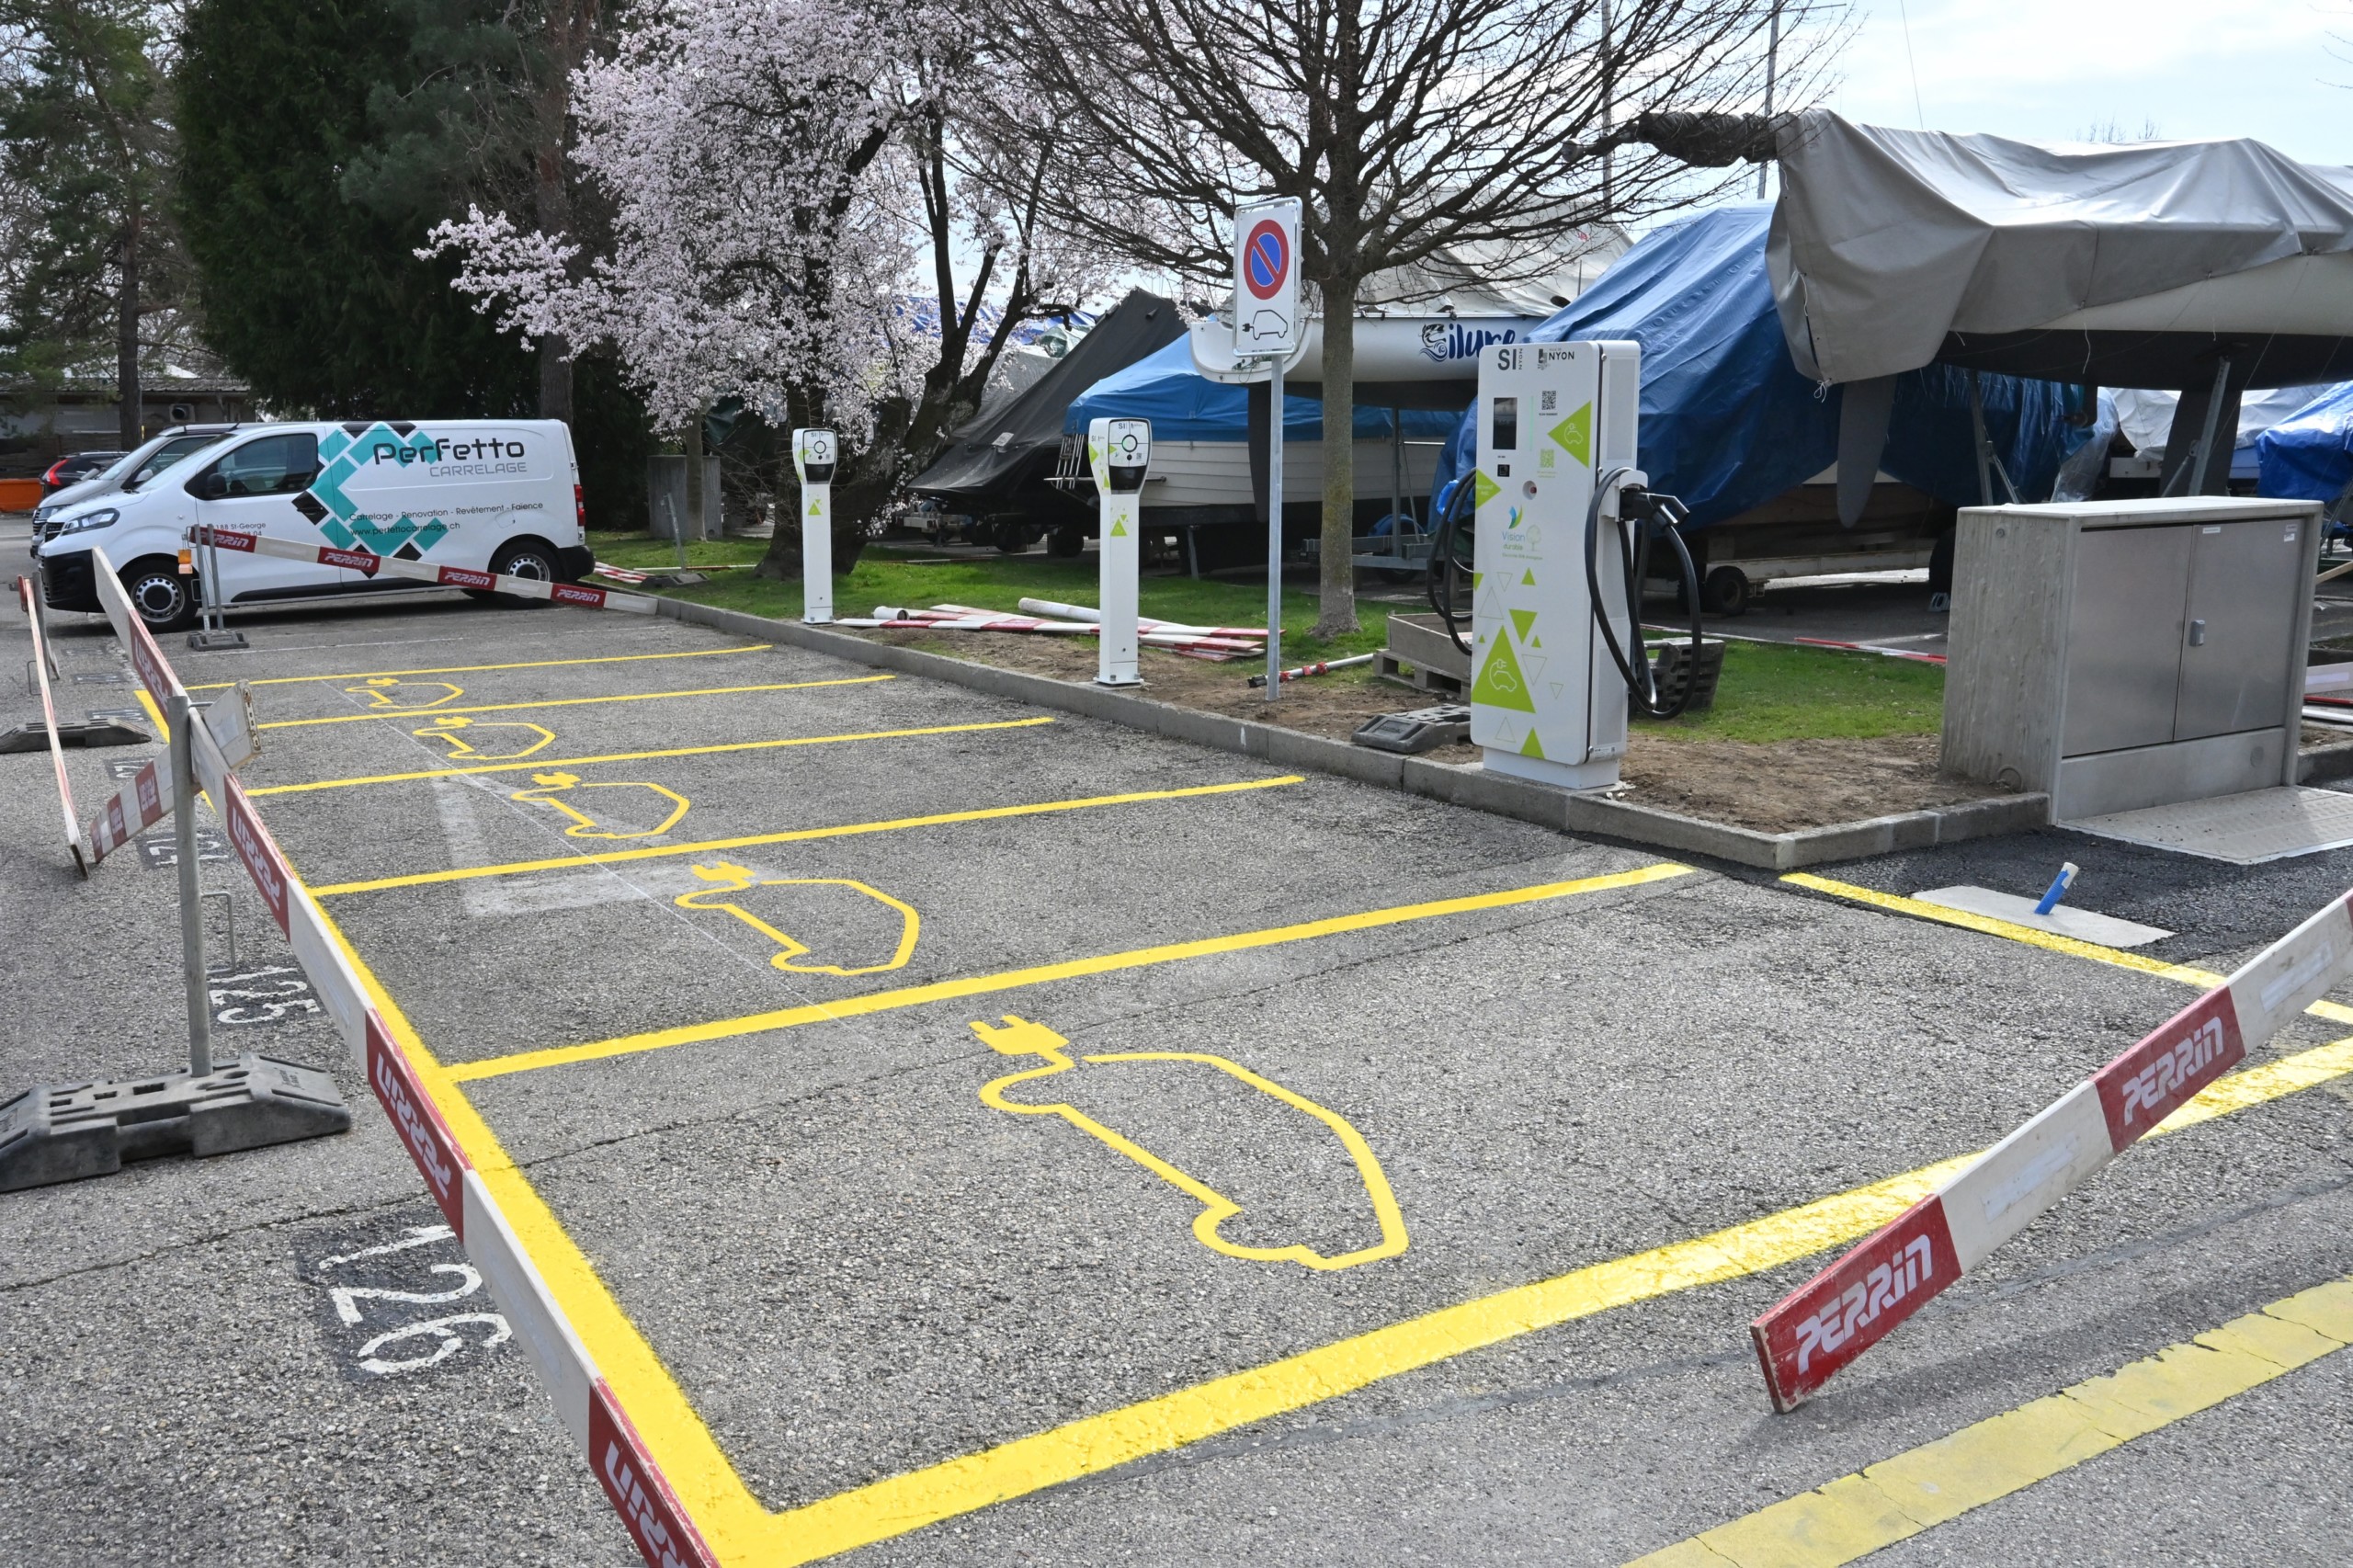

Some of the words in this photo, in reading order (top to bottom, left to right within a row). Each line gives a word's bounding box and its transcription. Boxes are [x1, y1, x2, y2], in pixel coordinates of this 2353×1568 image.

[1497, 348, 1518, 371] SI
[1549, 351, 1575, 361] NYON
[429, 461, 528, 478] CARRELAGE
[349, 512, 393, 521] Carrelage
[401, 509, 449, 519] Renovation
[231, 522, 267, 530] St-George
[350, 522, 460, 537] www.perfettocarrelage.ch
[1501, 529, 1526, 542] Vision
